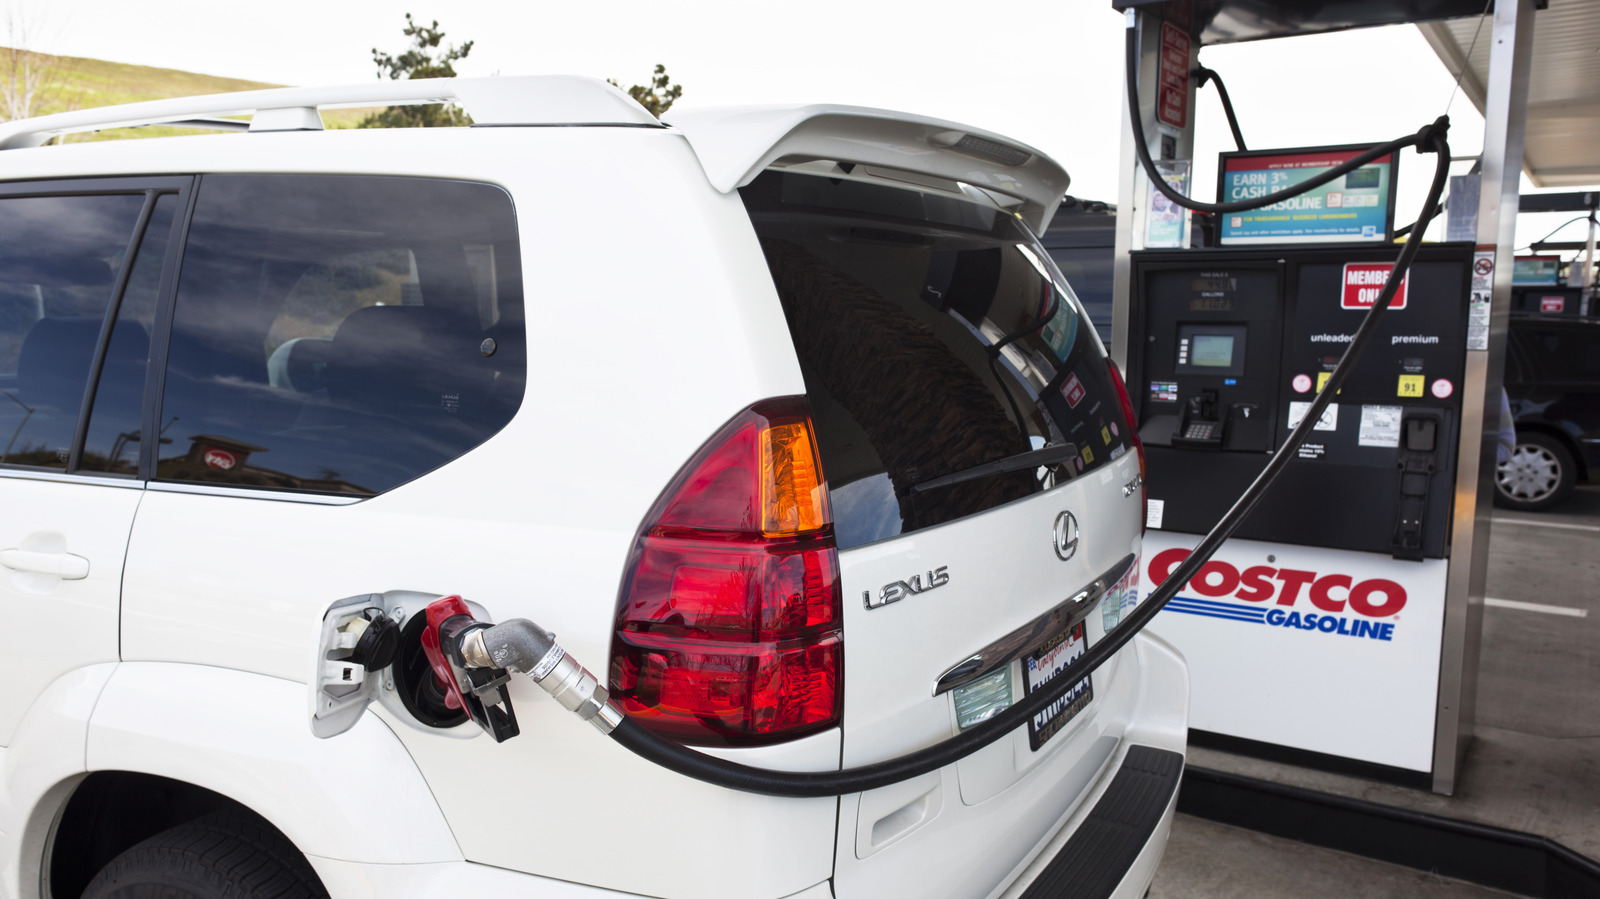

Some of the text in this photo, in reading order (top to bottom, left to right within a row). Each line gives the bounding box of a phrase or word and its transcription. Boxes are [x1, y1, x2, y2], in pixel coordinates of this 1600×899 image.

[1233, 172, 1288, 186] EARN 3%
[1232, 187, 1267, 199] CASH
[1347, 270, 1404, 285] MEMBE
[1358, 288, 1379, 303] ON
[1310, 333, 1358, 343] unleaded
[1391, 334, 1439, 345] premium
[1404, 383, 1416, 392] 91
[862, 565, 949, 610] LEXUS
[1147, 547, 1407, 617] COSTCO
[1265, 608, 1395, 641] GASOLINE
